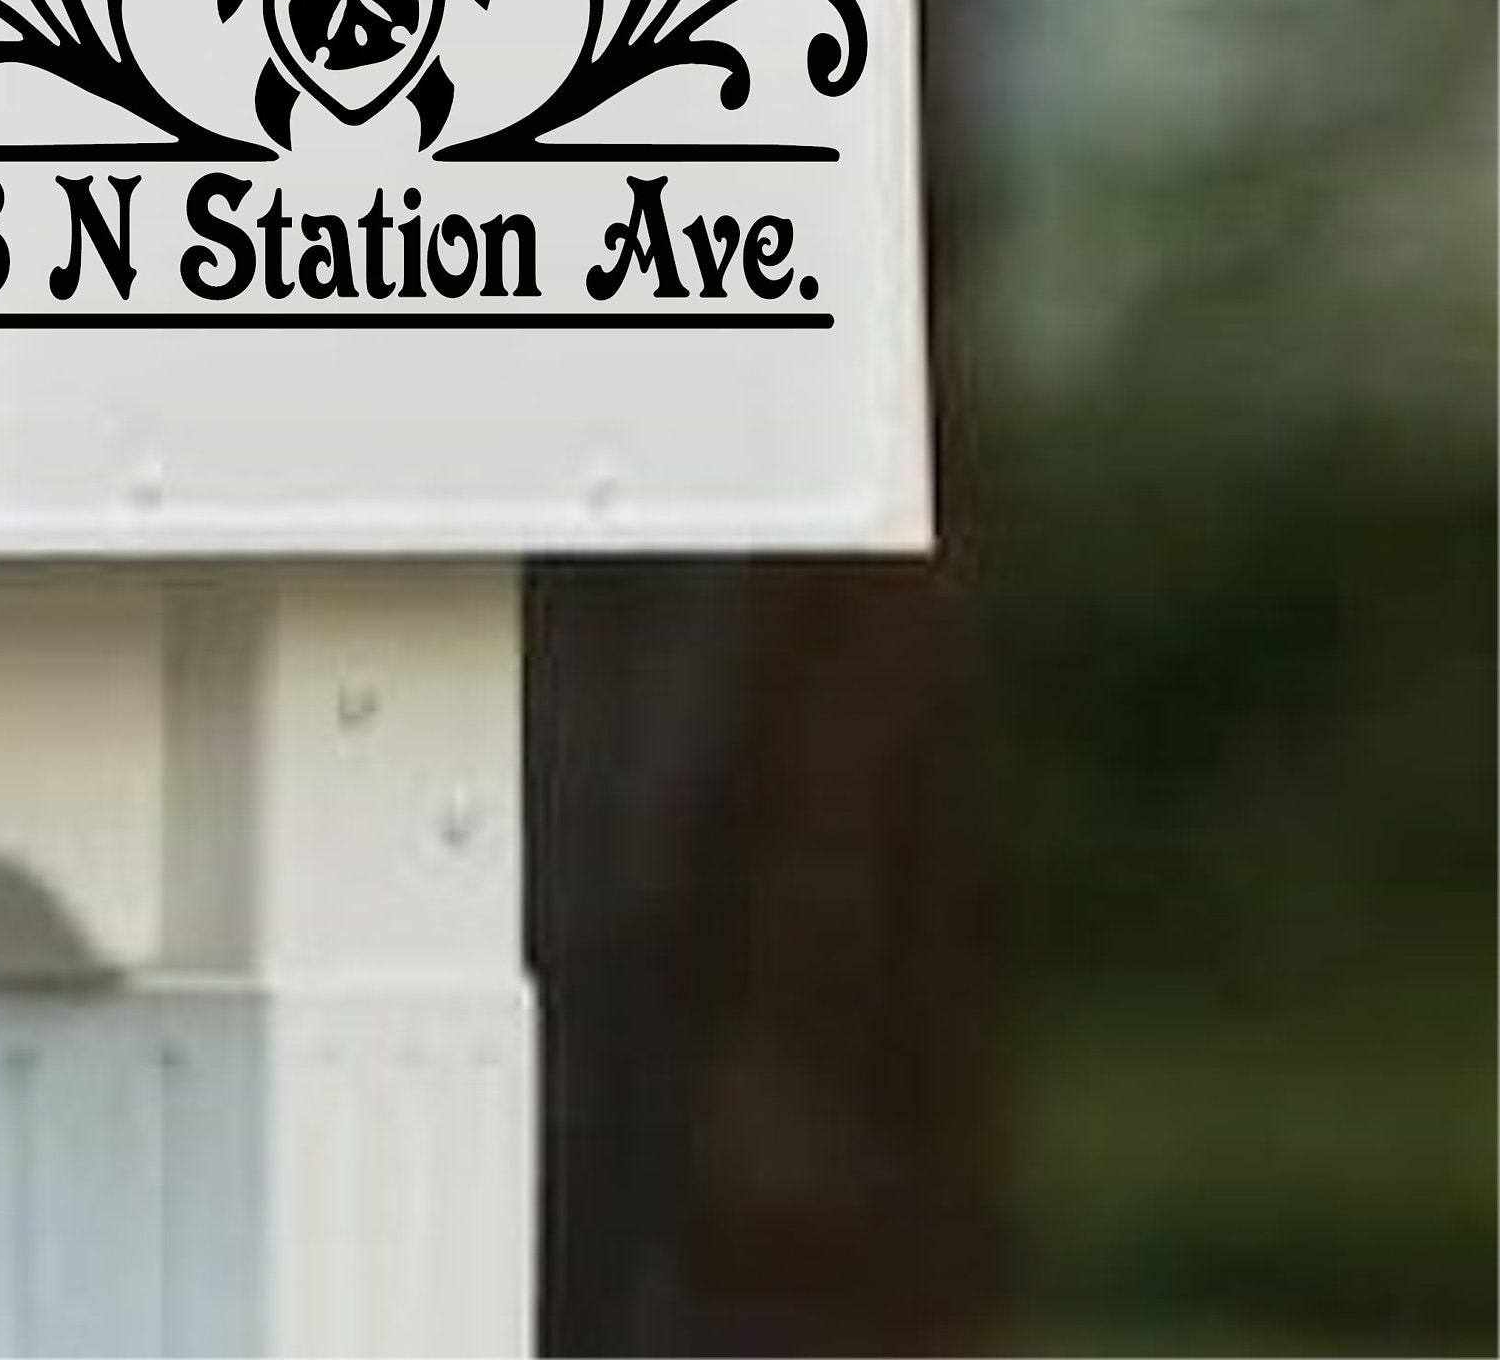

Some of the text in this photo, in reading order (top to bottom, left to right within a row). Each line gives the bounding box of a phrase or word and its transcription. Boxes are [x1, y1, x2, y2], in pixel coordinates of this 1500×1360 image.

[49, 174, 142, 301] N
[180, 172, 542, 300] Station
[585, 175, 819, 301] Ave.
